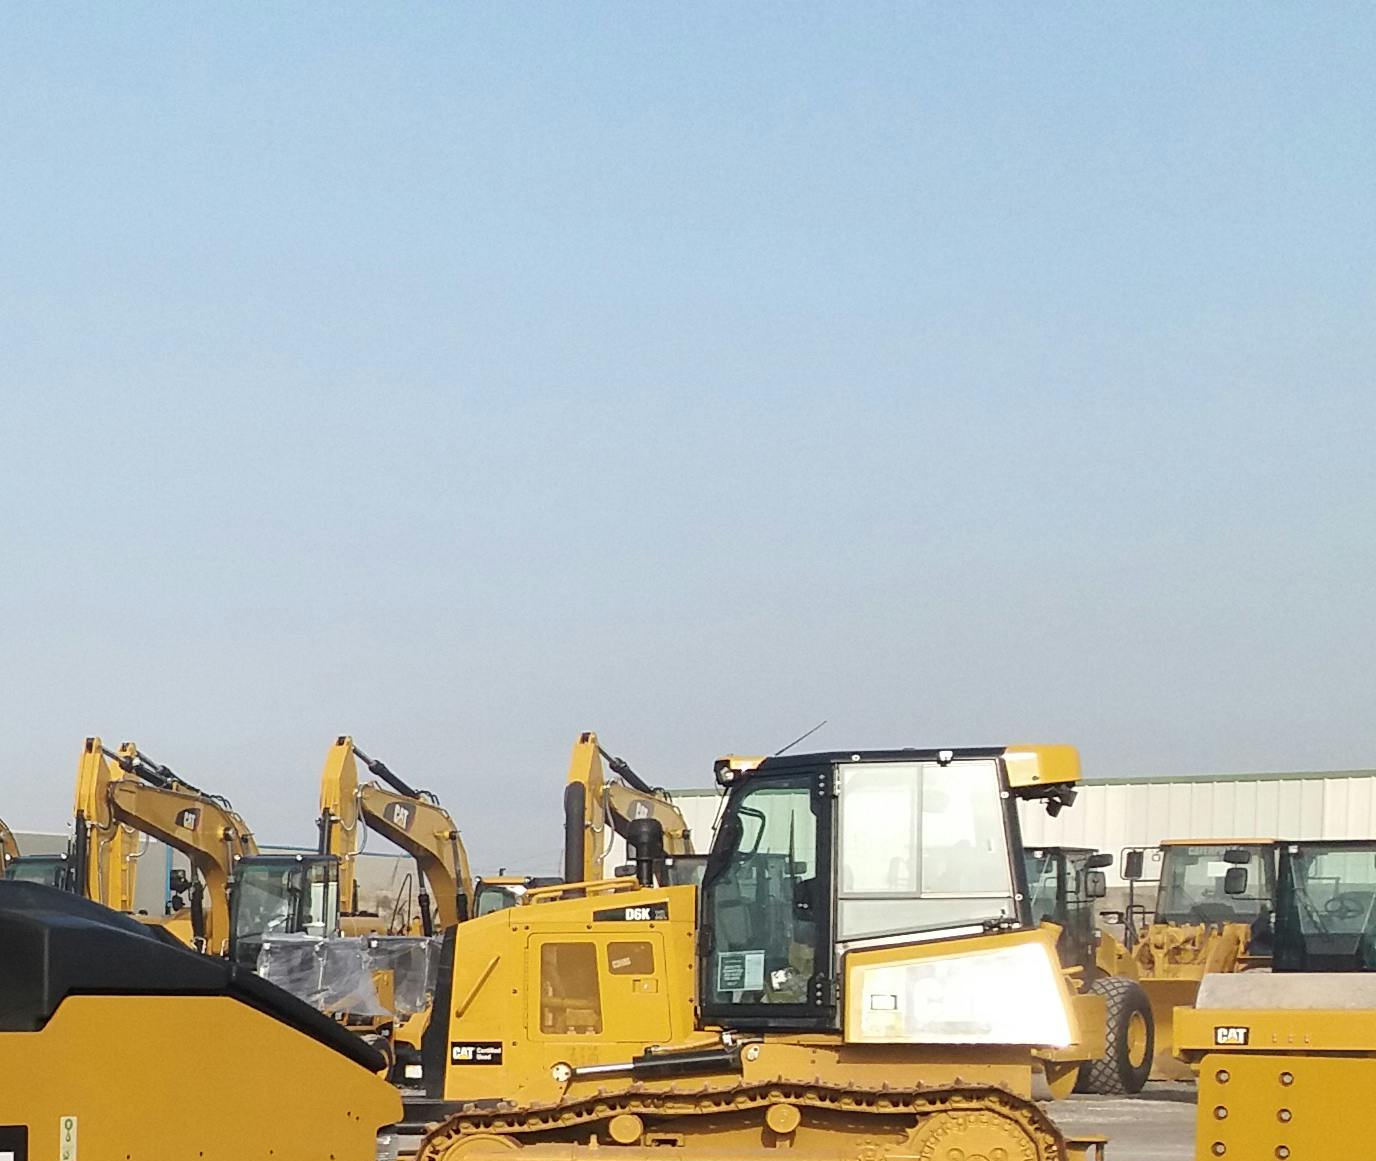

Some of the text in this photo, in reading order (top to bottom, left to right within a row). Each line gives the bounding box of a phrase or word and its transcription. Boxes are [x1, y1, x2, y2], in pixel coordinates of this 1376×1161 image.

[184, 811, 196, 830] CAT
[393, 803, 409, 829] CAT
[625, 907, 651, 921] D6K
[1216, 1027, 1247, 1044] CAT
[452, 1046, 475, 1060] CAT
